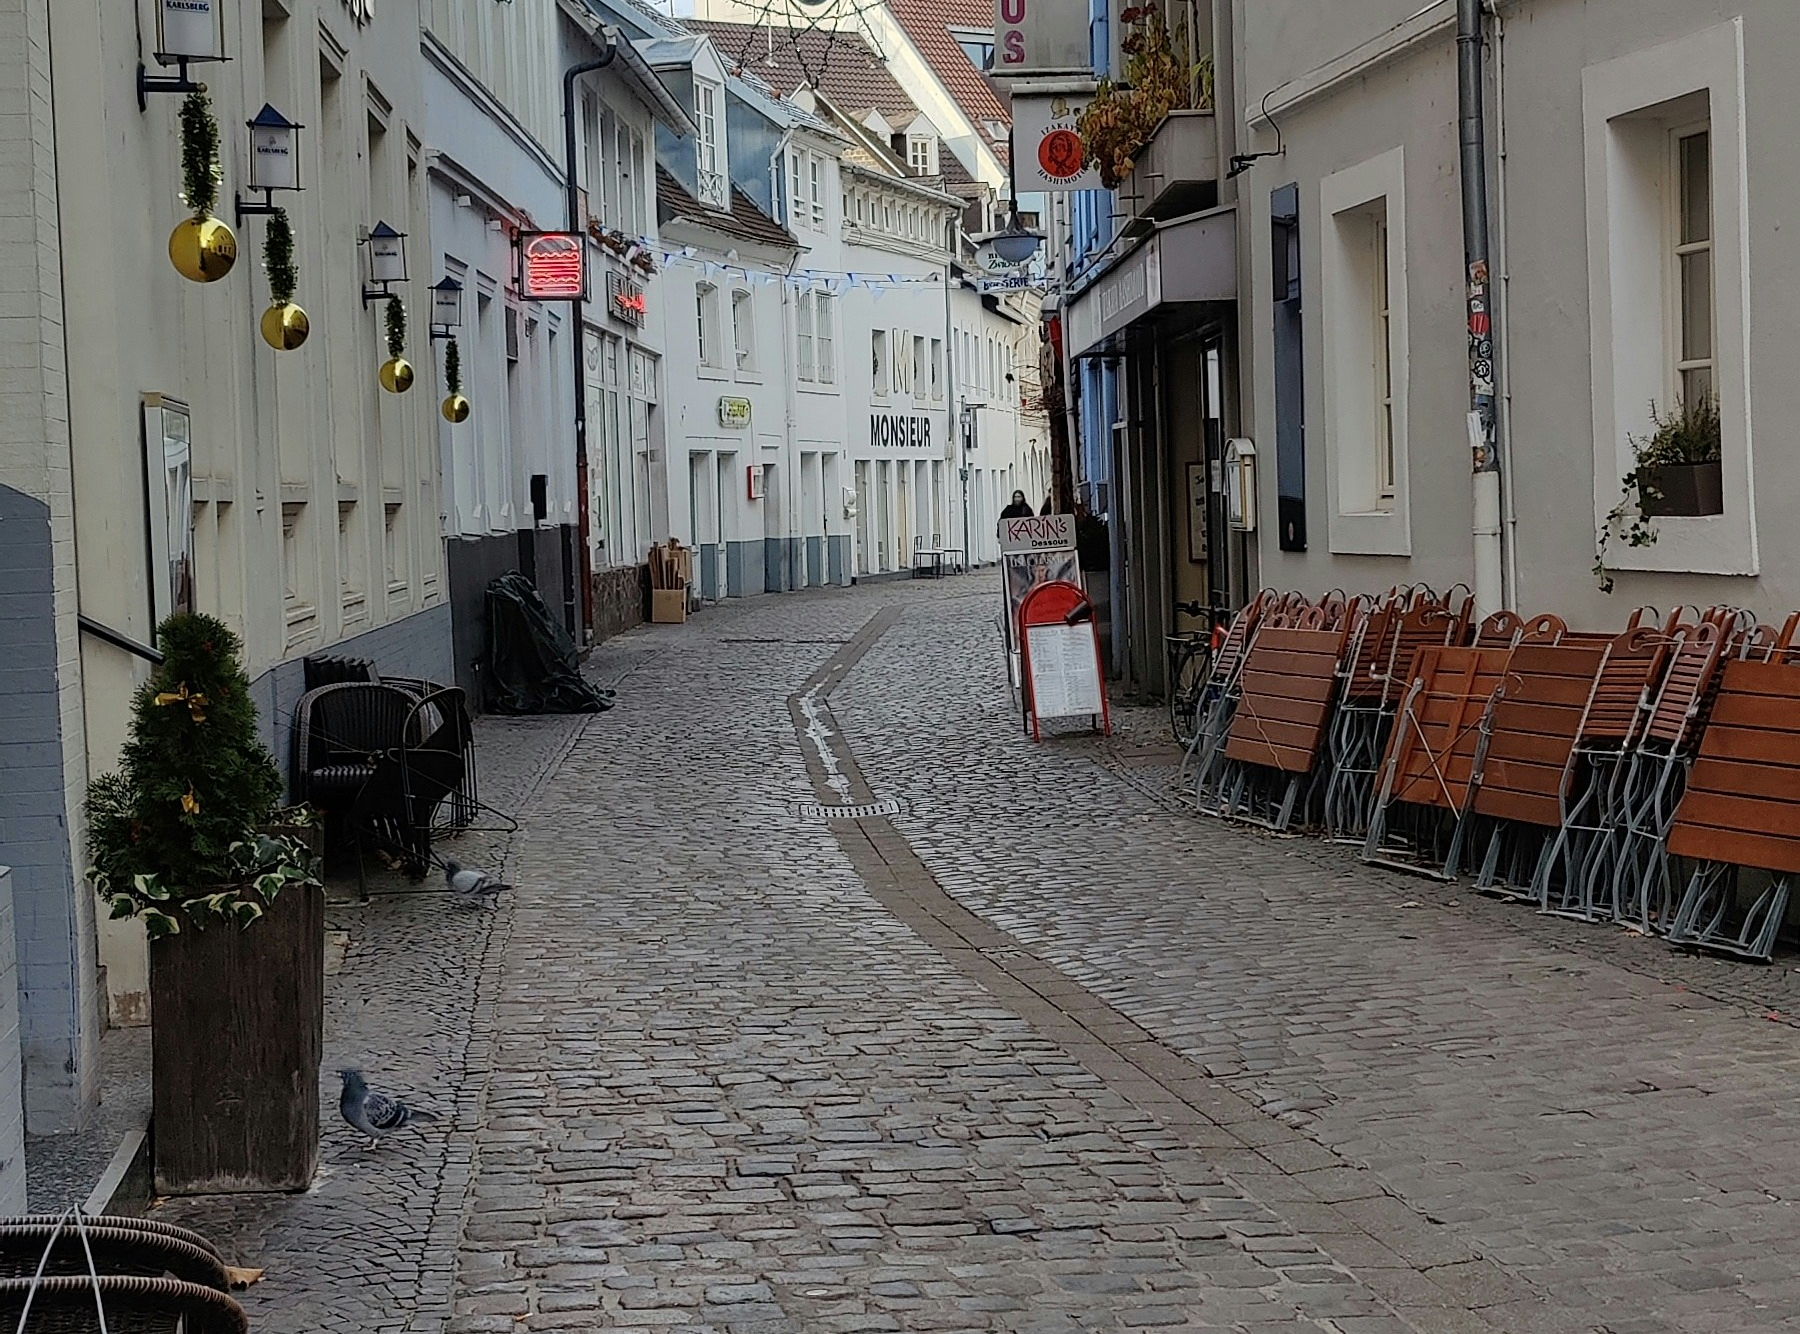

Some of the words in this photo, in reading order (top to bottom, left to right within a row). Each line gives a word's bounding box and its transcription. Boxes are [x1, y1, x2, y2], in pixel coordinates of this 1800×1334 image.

[166, 0, 210, 12] KARLSBERG
[870, 414, 931, 447] MONSIEUR
[1032, 539, 1068, 547] Dessous
